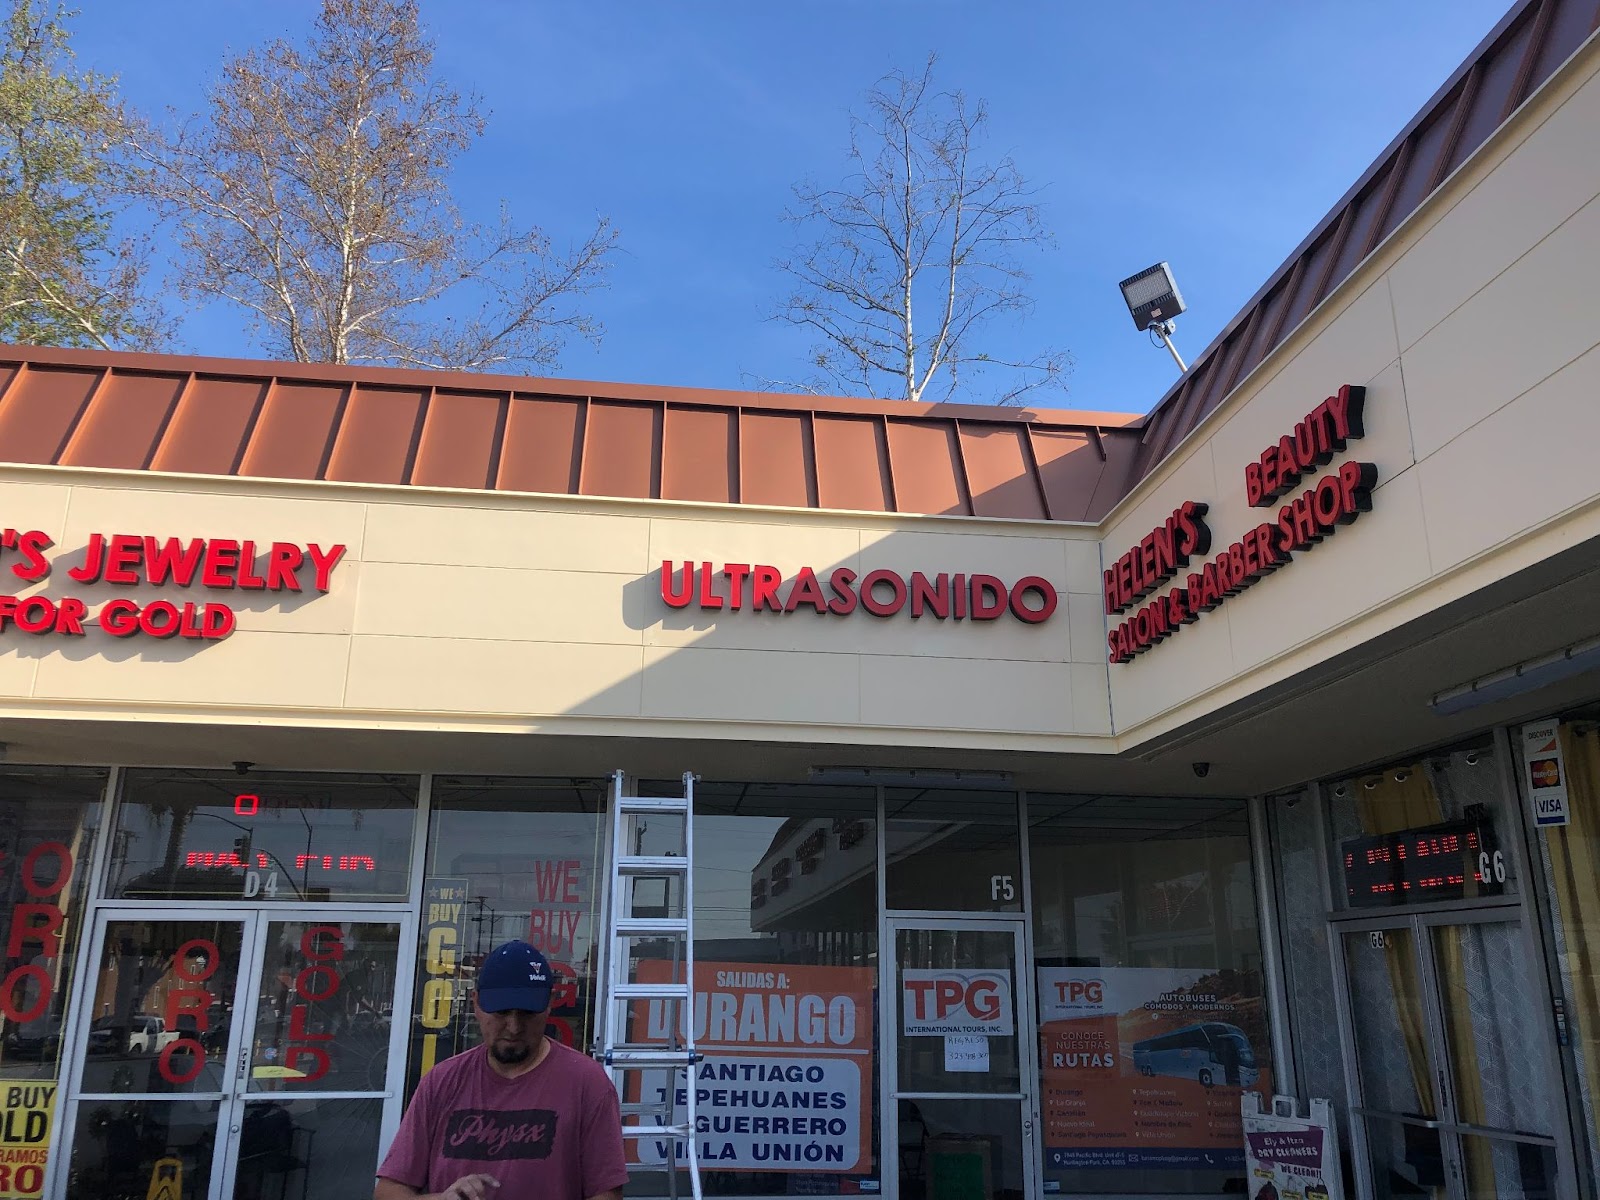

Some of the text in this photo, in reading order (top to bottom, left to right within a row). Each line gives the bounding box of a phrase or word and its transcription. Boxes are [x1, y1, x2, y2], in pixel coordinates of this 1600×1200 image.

[1103, 384, 1366, 615] HELEN'S BEAUTY
[67, 533, 347, 594] JEWELRY
[1108, 460, 1378, 664] SALON & BARBER SHOP
[660, 559, 1058, 625] ULTRASONIDO
[99, 598, 236, 641] GOLD
[1528, 728, 1554, 740] DISCOVER
[1538, 799, 1562, 813] VISA
[535, 860, 581, 904] WE
[991, 875, 1014, 901] F5
[439, 887, 454, 900] WE
[427, 903, 462, 925] BUY
[529, 909, 582, 956] BUY
[716, 970, 790, 990] SALIDAS A:
[904, 979, 1001, 1021] TPG
[1054, 981, 1104, 1004] TPG
[1160, 994, 1217, 1003] AUTOBUSES
[1191, 1003, 1235, 1011] MODERNOS
[647, 992, 856, 1045] DURANGO
[905, 1025, 1003, 1035] INTERNATIONAL TOURS, INC.
[1061, 1031, 1104, 1040] CONOCE
[1056, 1040, 1111, 1050] NUESTRAS
[1053, 1052, 1115, 1068] RUTAS
[6, 1087, 56, 1108] BUY
[656, 1088, 848, 1110] TEPEHUANES
[0, 1110, 48, 1142] LD
[450, 1114, 546, 1156] Physx
[695, 1115, 848, 1136] GUERRERO
[655, 1141, 845, 1162] VILA UNIÓN
[1257, 1146, 1319, 1158] DRY CLEANERS
